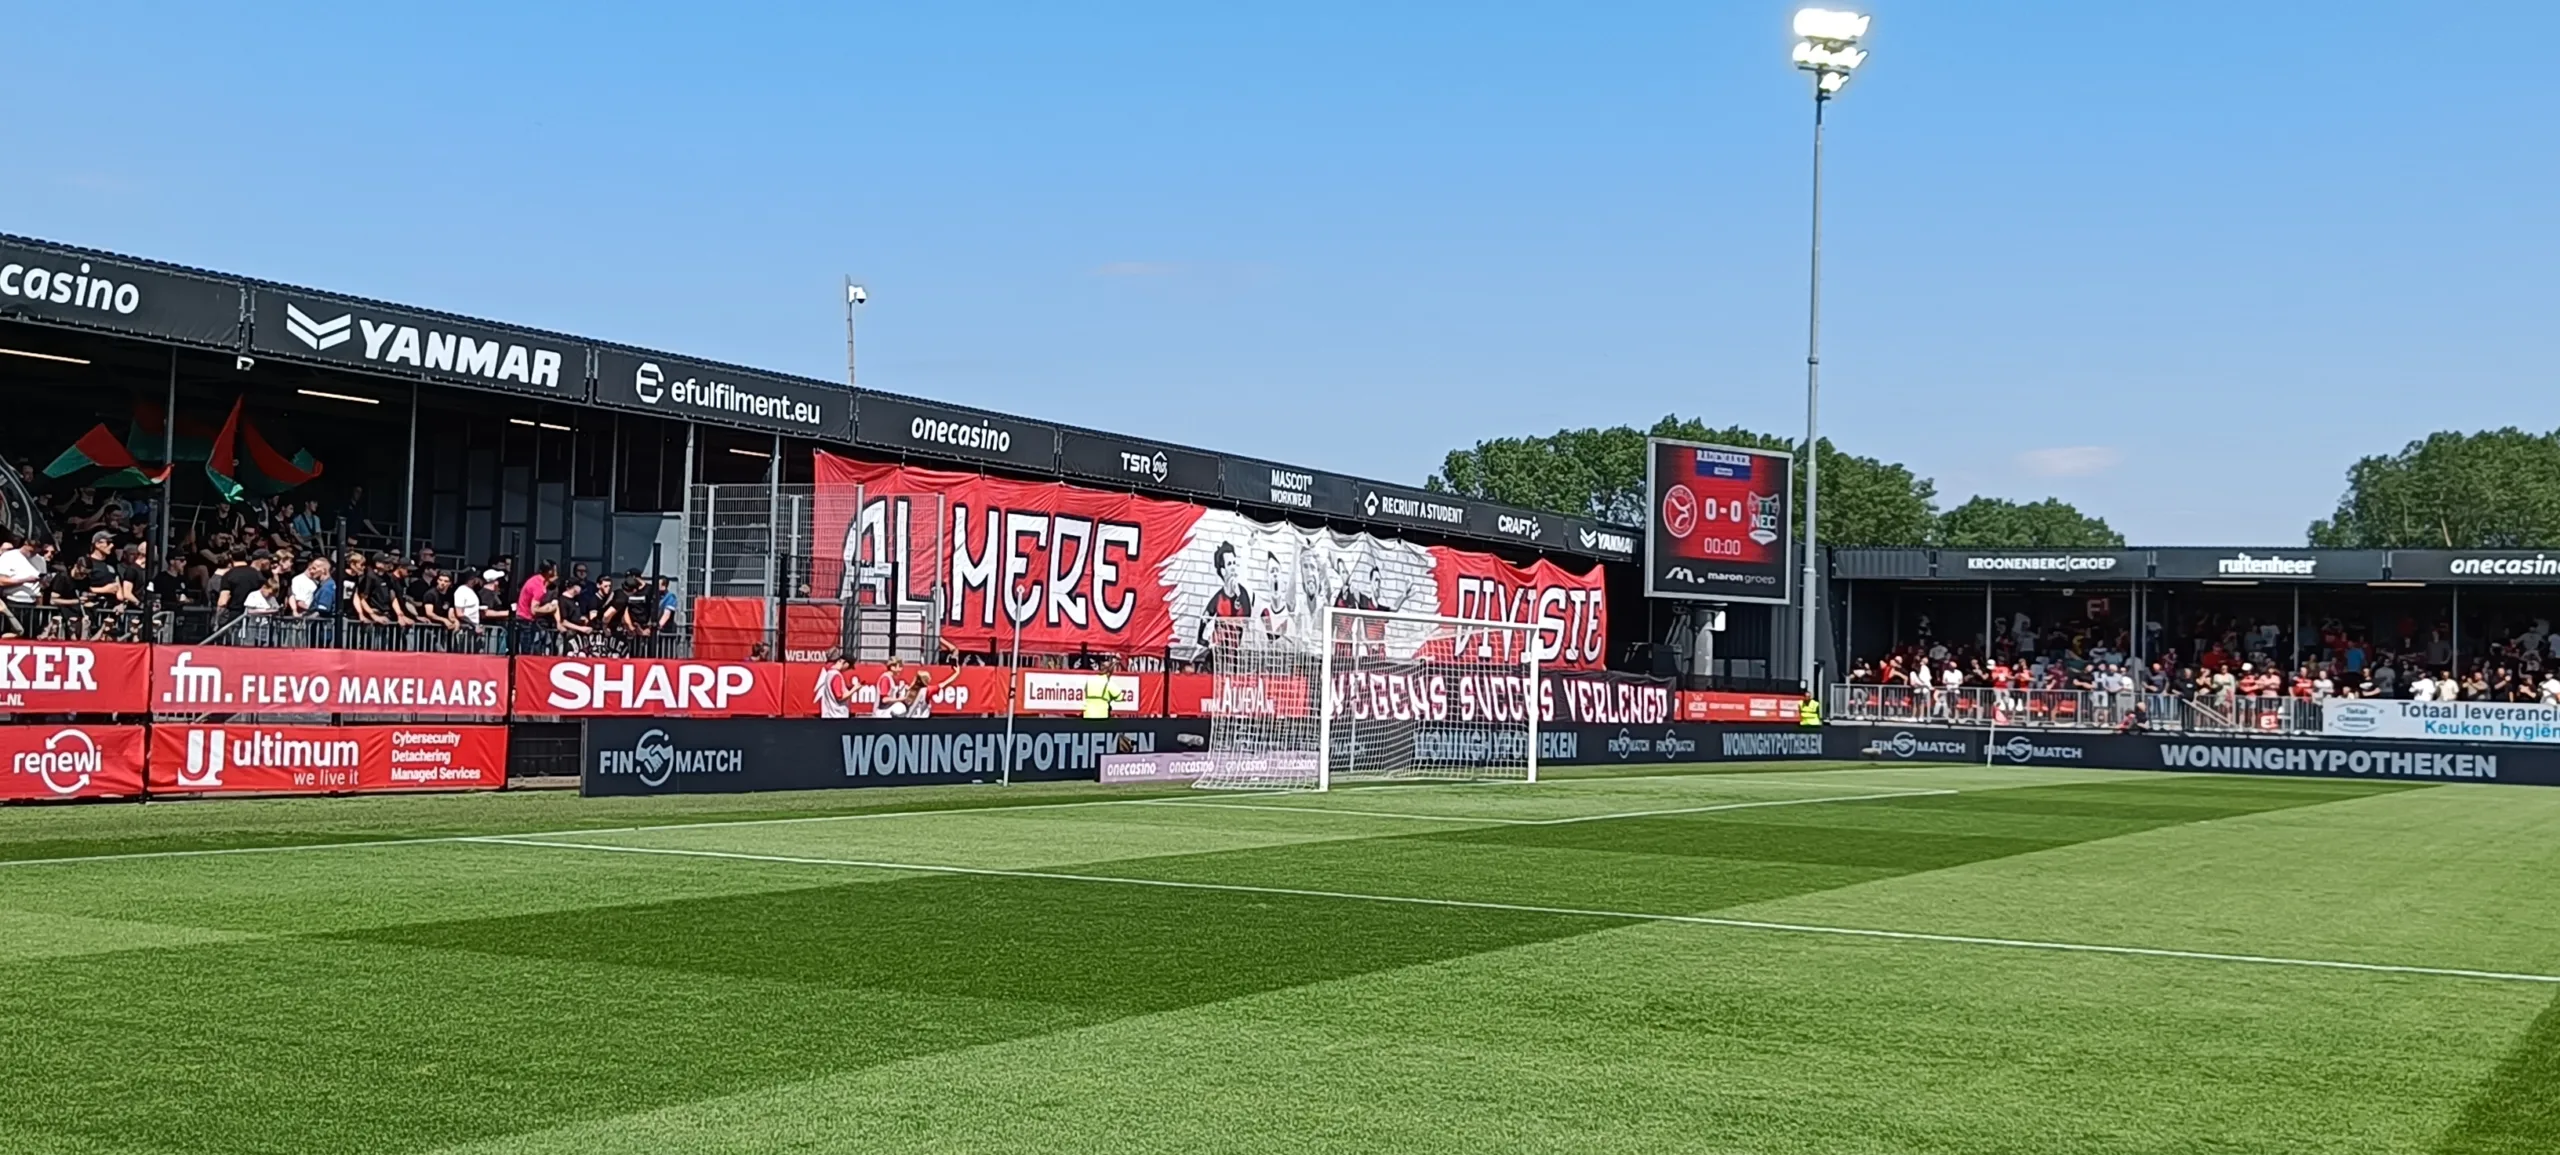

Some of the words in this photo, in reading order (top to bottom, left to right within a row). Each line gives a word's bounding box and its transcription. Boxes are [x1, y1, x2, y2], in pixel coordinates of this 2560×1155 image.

[359, 318, 562, 388] YANMAR
[671, 378, 820, 425] efulfilment.eu
[911, 415, 1011, 453] onecasino
[1121, 452, 1150, 474] TSR
[1271, 488, 1312, 508] WORKWEAR
[1382, 496, 1420, 517] RECRUIT
[1420, 504, 1428, 518] A
[1427, 506, 1464, 525] STUDENT
[1498, 514, 1531, 536] CRAFT
[1704, 537, 1741, 556] 00:00
[839, 498, 1140, 629] ALMERE
[2218, 552, 2317, 574] ruitenheer
[2450, 554, 2560, 575] onecasin
[1707, 571, 1744, 583] maron
[1744, 574, 1776, 585] groep
[242, 674, 330, 704] FLEVO
[338, 678, 497, 707] MAKELAARS
[548, 661, 754, 709] SHARP
[2398, 702, 2458, 719] Totaal
[2464, 703, 2560, 722] leveranci
[391, 731, 461, 748] Cybersecurity
[2425, 721, 2493, 737] Keuken
[233, 731, 359, 768] ultimum
[1414, 731, 1578, 759] WONINGHYPOTEKEN
[1722, 732, 1823, 756] WONINGHYPOTHEKEN
[1917, 741, 1966, 754] MATCH
[2032, 747, 2083, 759] MATCH
[14, 744, 102, 773] renewi
[391, 749, 451, 766] Detachering
[675, 750, 742, 773] MATCH
[1107, 758, 1157, 777] onecasino
[1169, 757, 1215, 776] onecasino
[2161, 744, 2497, 778] WONINGHYPOTHEKEN
[294, 773, 314, 785] we
[319, 770, 344, 786] live
[349, 771, 359, 785] it
[391, 767, 437, 784] Managed
[440, 767, 481, 781] Services
